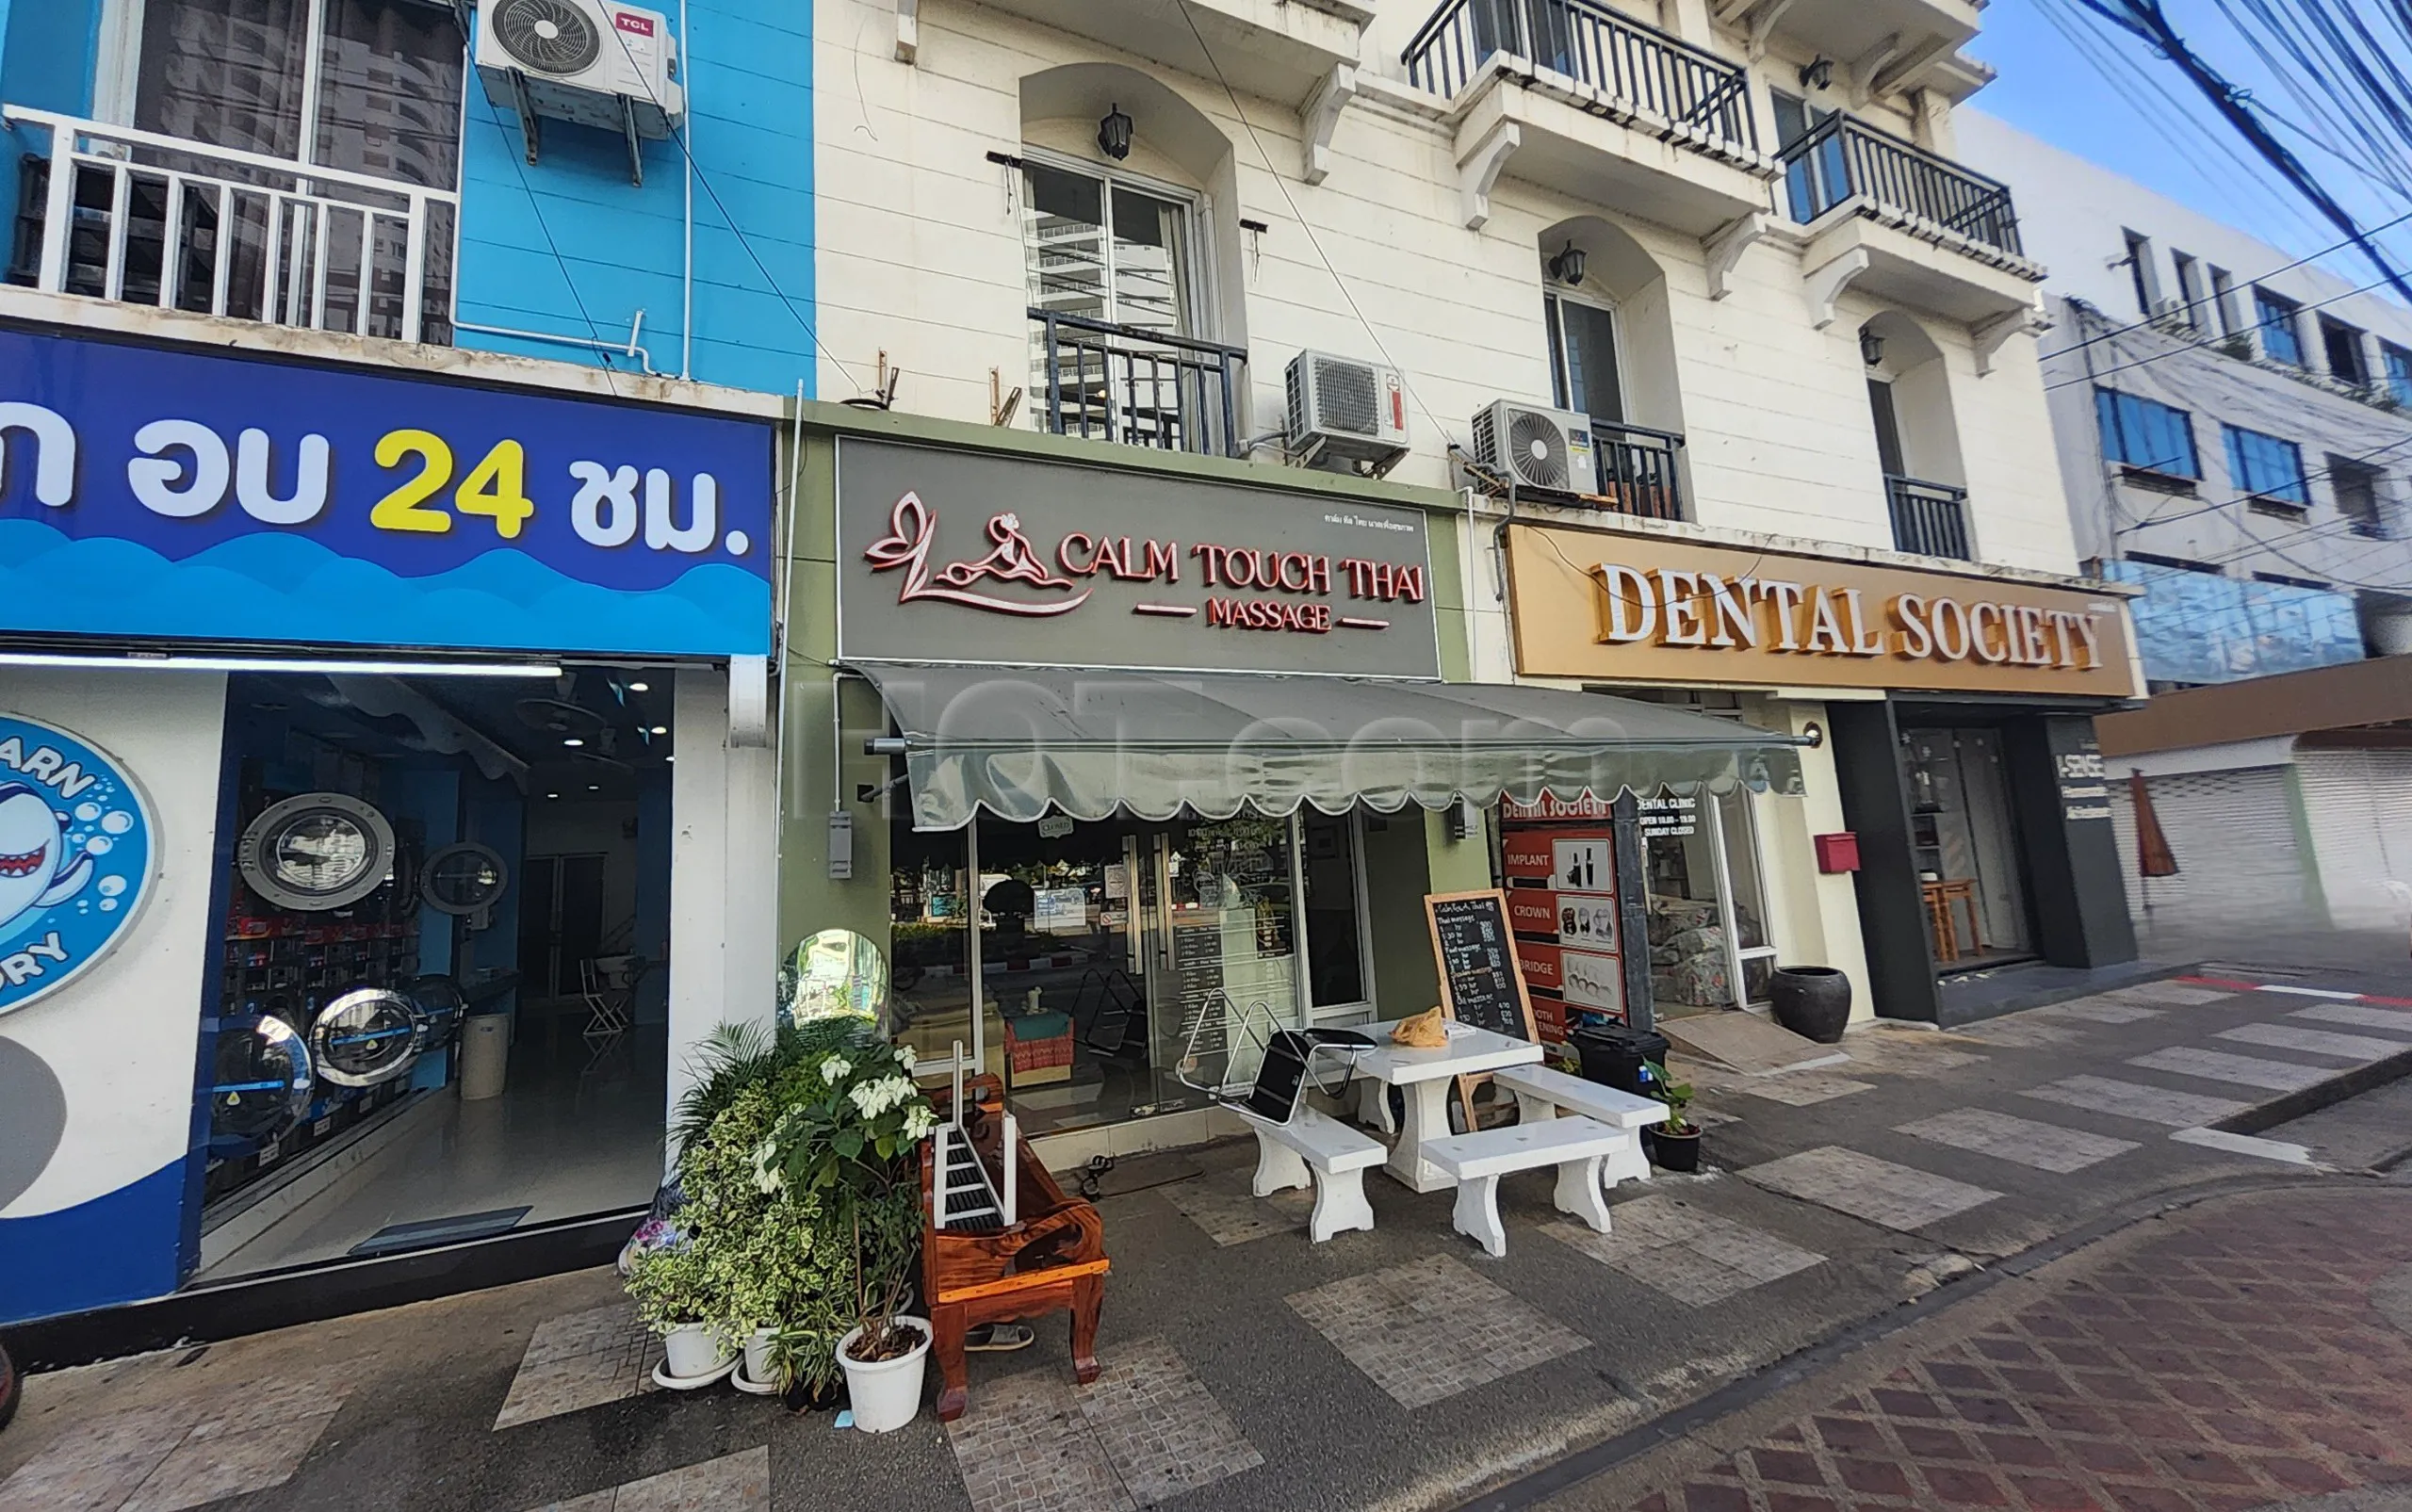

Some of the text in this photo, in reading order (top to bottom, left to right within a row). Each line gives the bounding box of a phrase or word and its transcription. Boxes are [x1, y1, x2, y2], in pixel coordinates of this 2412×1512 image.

[620, 17, 649, 32] TCL
[128, 418, 330, 525] อบ
[370, 429, 534, 539] 24
[569, 460, 750, 556] ชม.
[1057, 532, 1424, 603] CALM TOUCH THAI
[1207, 596, 1332, 632] MASSAGE
[1592, 562, 2103, 671] DENTAL SOCIETY
[1670, 825, 1695, 836] CLOSED
[1507, 854, 1550, 868] IMPLANT
[1513, 904, 1550, 919] CROWN
[0, 931, 69, 988] RY
[1520, 959, 1554, 976] BRIDGE
[1534, 1009, 1554, 1022] OTH
[1537, 1022, 1565, 1036] ENING
